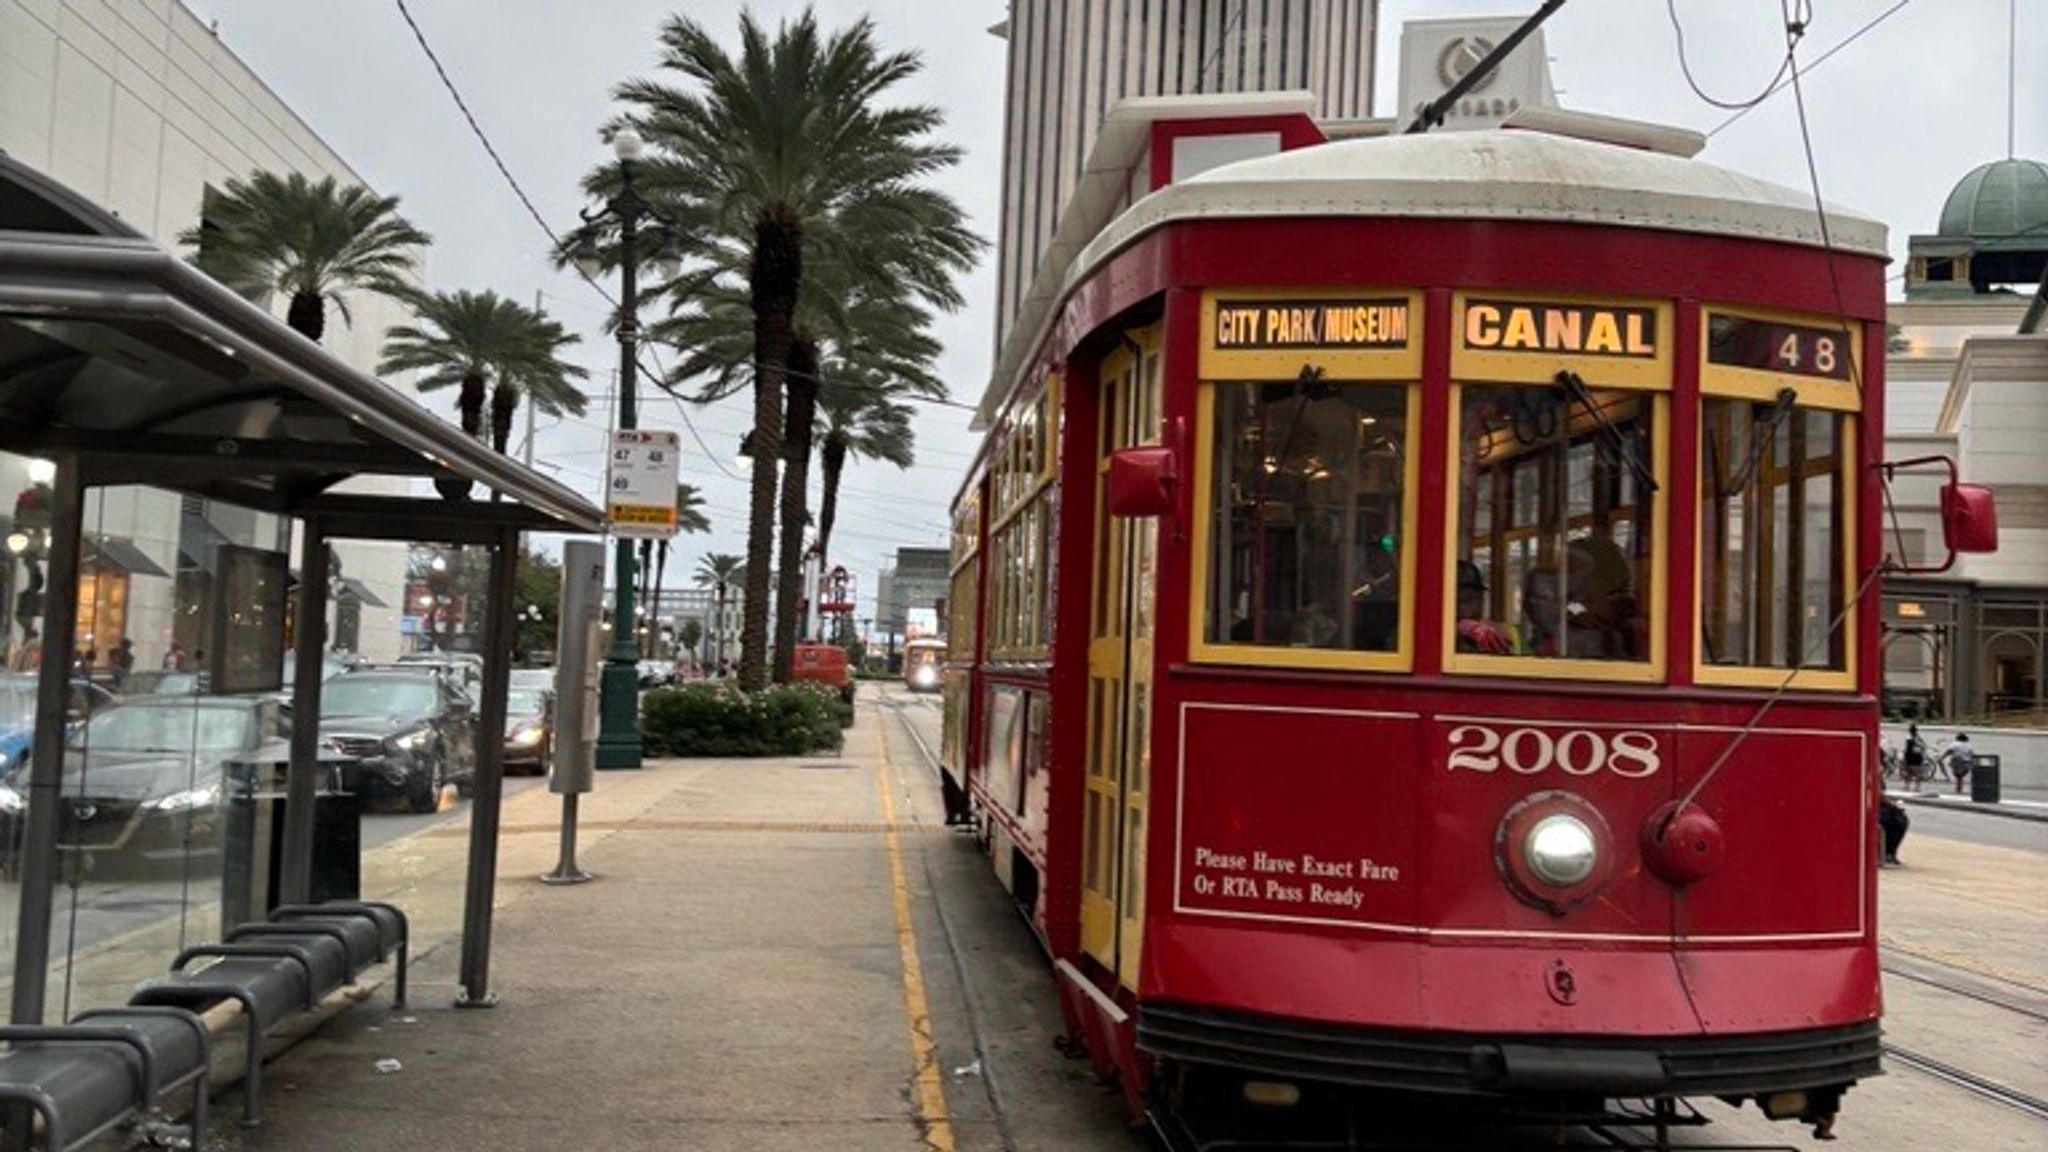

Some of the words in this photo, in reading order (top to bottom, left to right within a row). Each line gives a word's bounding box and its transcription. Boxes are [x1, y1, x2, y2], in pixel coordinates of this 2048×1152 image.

[1218, 309, 1260, 343] CITY
[1466, 306, 1654, 354] CANAL
[614, 448, 630, 460] 47
[1448, 725, 1660, 777] 2008
[1195, 847, 1246, 870] Please
[1253, 851, 1295, 873] Have
[1302, 855, 1353, 878] Exact
[1361, 858, 1399, 881] Fare
[1194, 874, 1216, 894] Or
[1222, 876, 1259, 898] RTA
[1266, 879, 1303, 901] Pass
[1310, 883, 1364, 909] Ready
